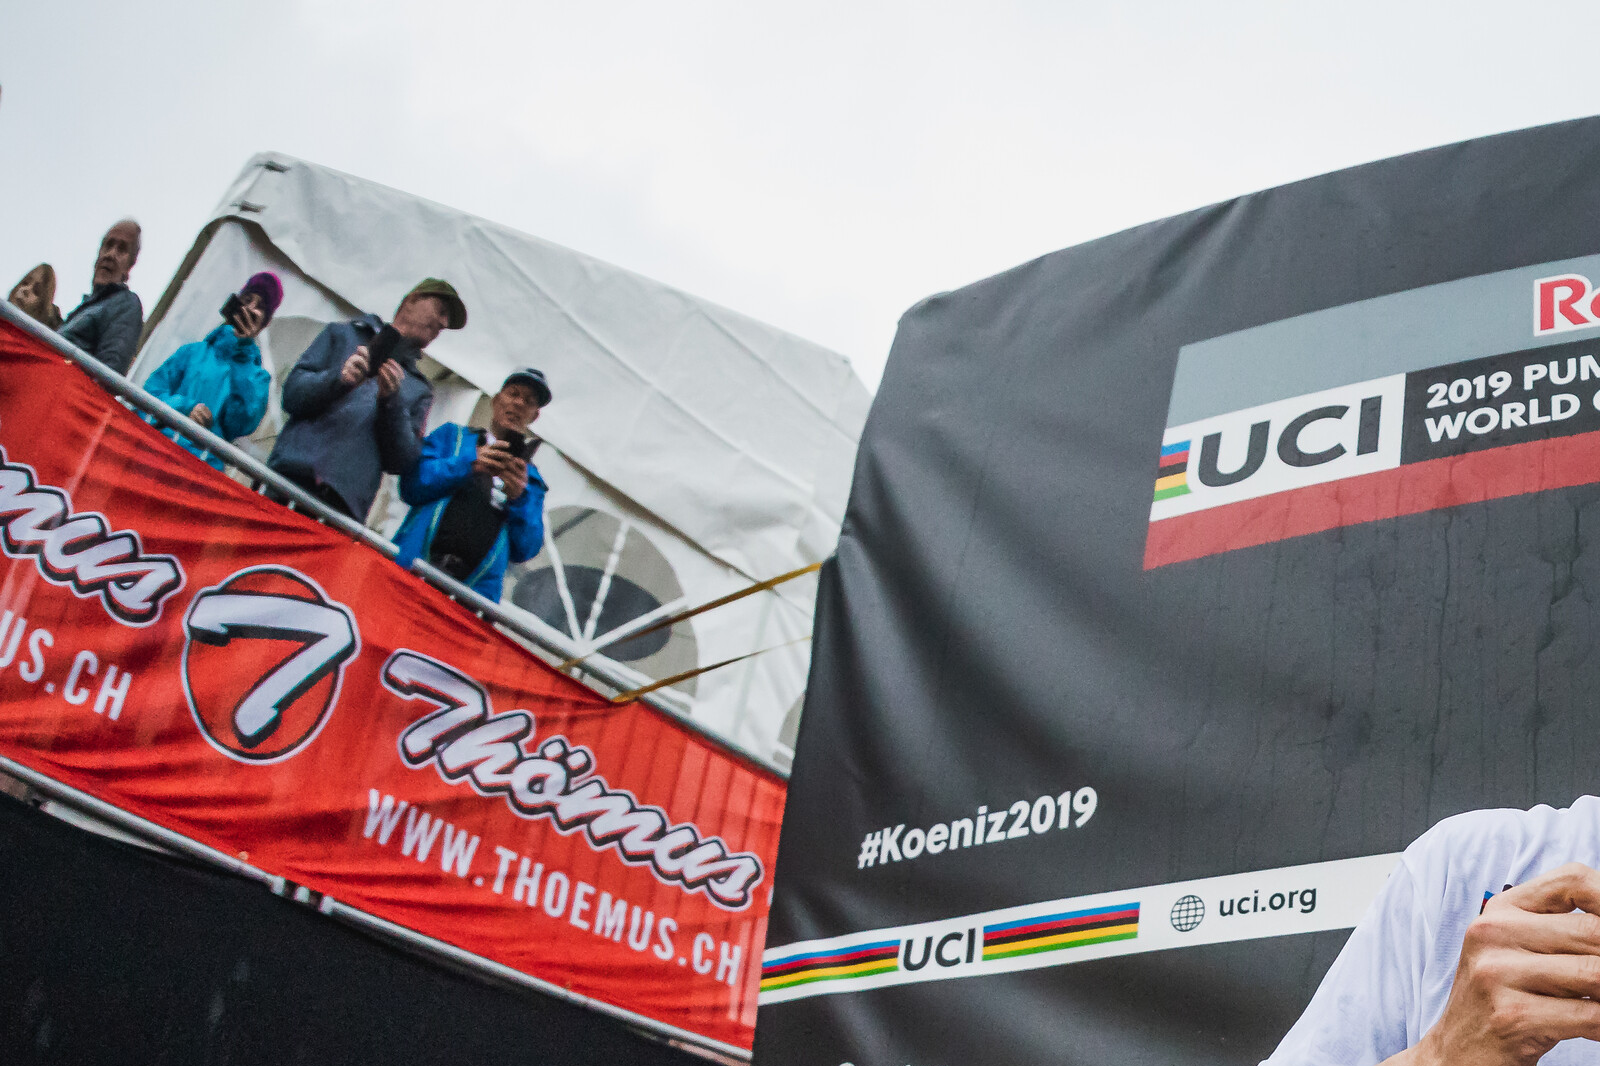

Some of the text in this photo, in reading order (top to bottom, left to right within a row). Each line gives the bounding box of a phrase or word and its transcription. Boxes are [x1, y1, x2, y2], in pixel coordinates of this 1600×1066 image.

[1425, 394, 1582, 443] WORLD
[1426, 370, 1514, 410] 2019
[1196, 394, 1384, 489] UCI
[380, 648, 766, 912] Thömus
[857, 787, 1098, 869] #Koeniz2019
[363, 788, 742, 986] WWW.THOEMUS.CH
[901, 885, 1318, 972] UCI uci.org
